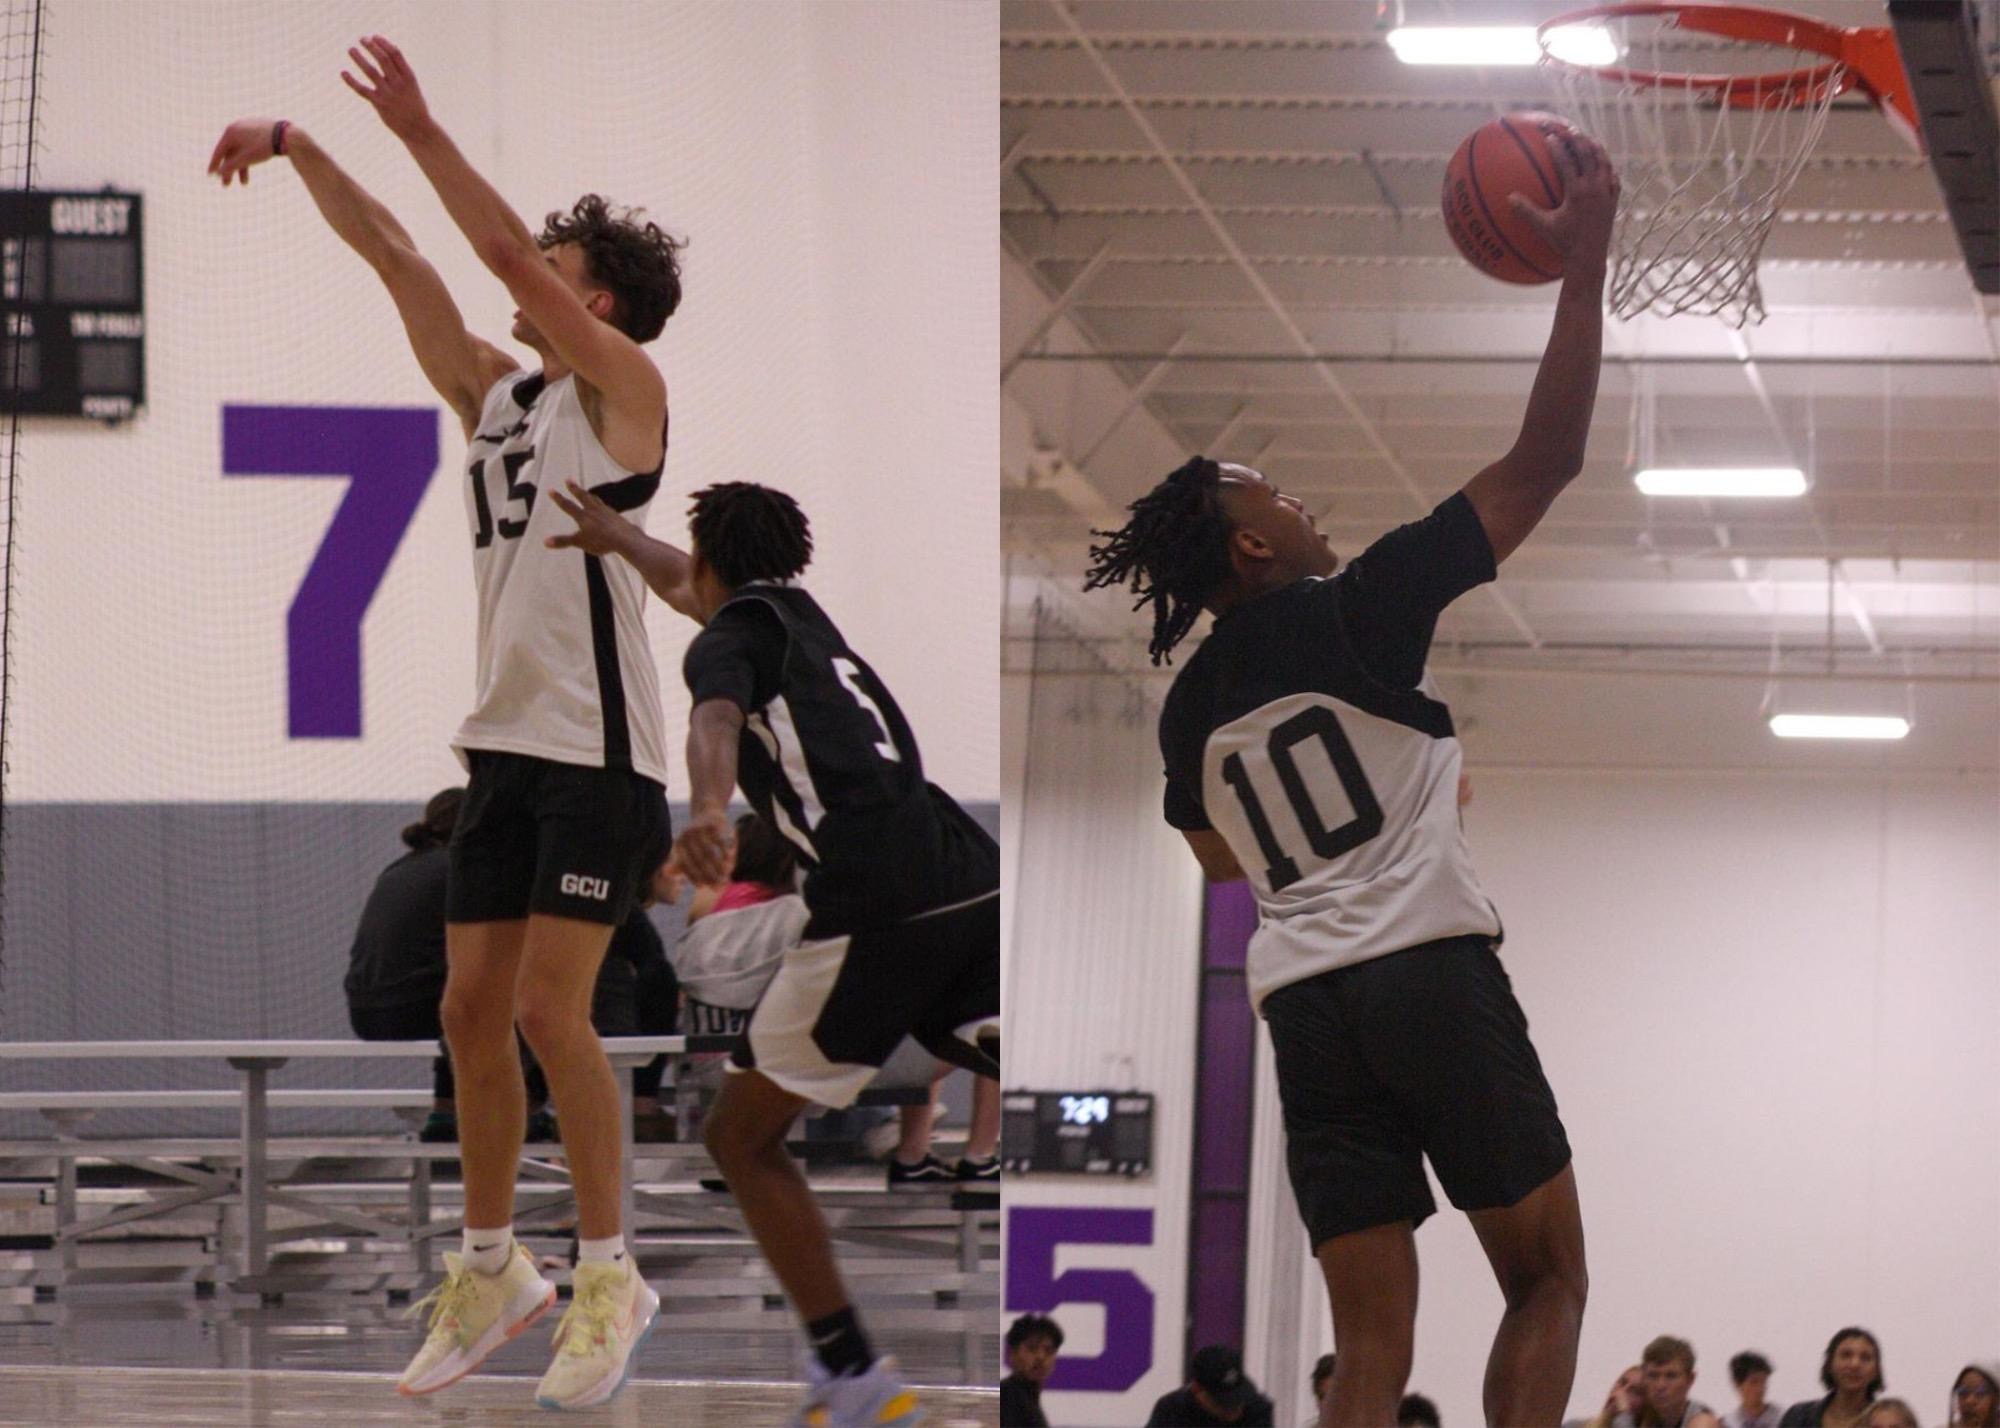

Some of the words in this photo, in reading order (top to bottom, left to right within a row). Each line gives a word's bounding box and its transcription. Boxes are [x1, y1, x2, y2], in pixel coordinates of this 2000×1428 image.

[51, 197, 131, 235] GUEST
[469, 445, 538, 549] 15
[223, 405, 439, 739] 7
[830, 657, 902, 764] 5
[1221, 705, 1386, 893] 10
[560, 873, 610, 900] GCU
[1004, 1206, 1155, 1392] 5
